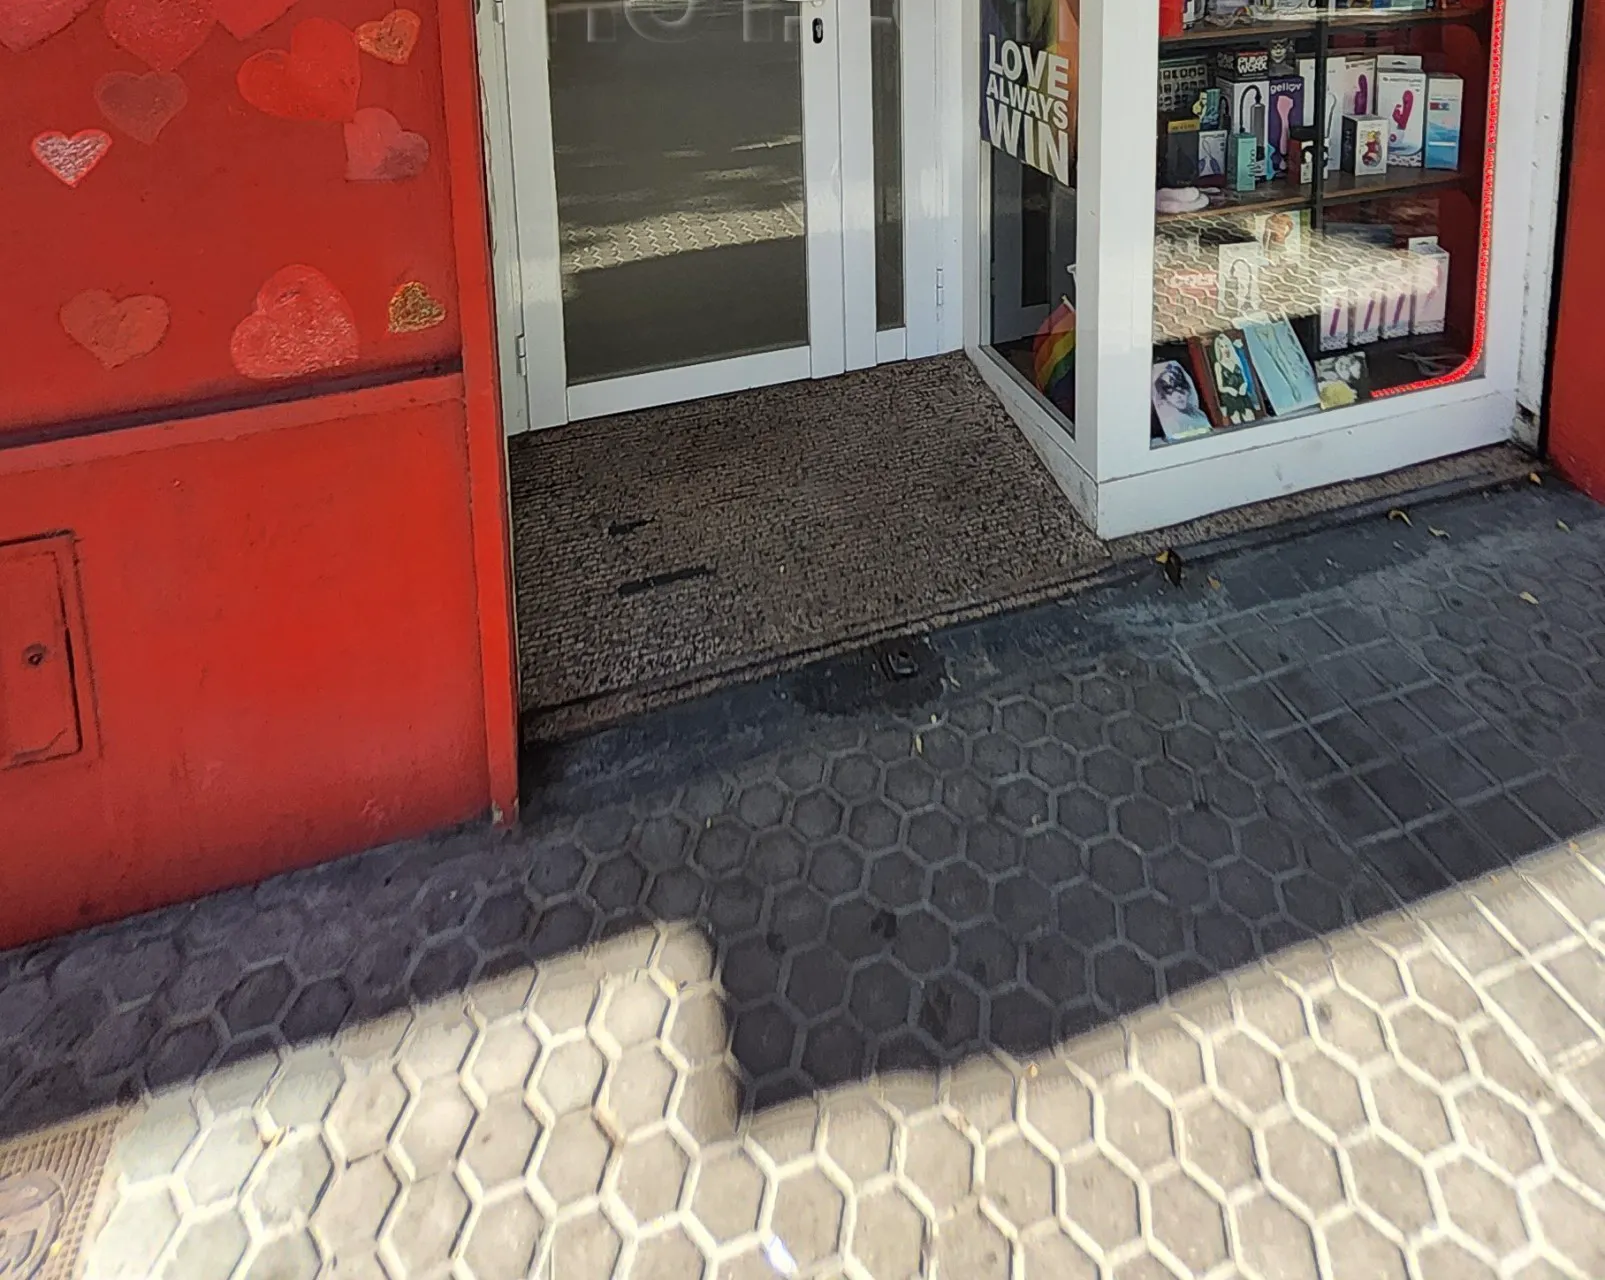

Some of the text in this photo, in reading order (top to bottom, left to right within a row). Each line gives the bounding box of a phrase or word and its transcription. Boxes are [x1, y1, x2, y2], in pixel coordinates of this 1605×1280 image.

[988, 34, 1069, 101] LOVE
[986, 74, 1069, 130] ALWAYS
[986, 97, 1069, 186] WIN
